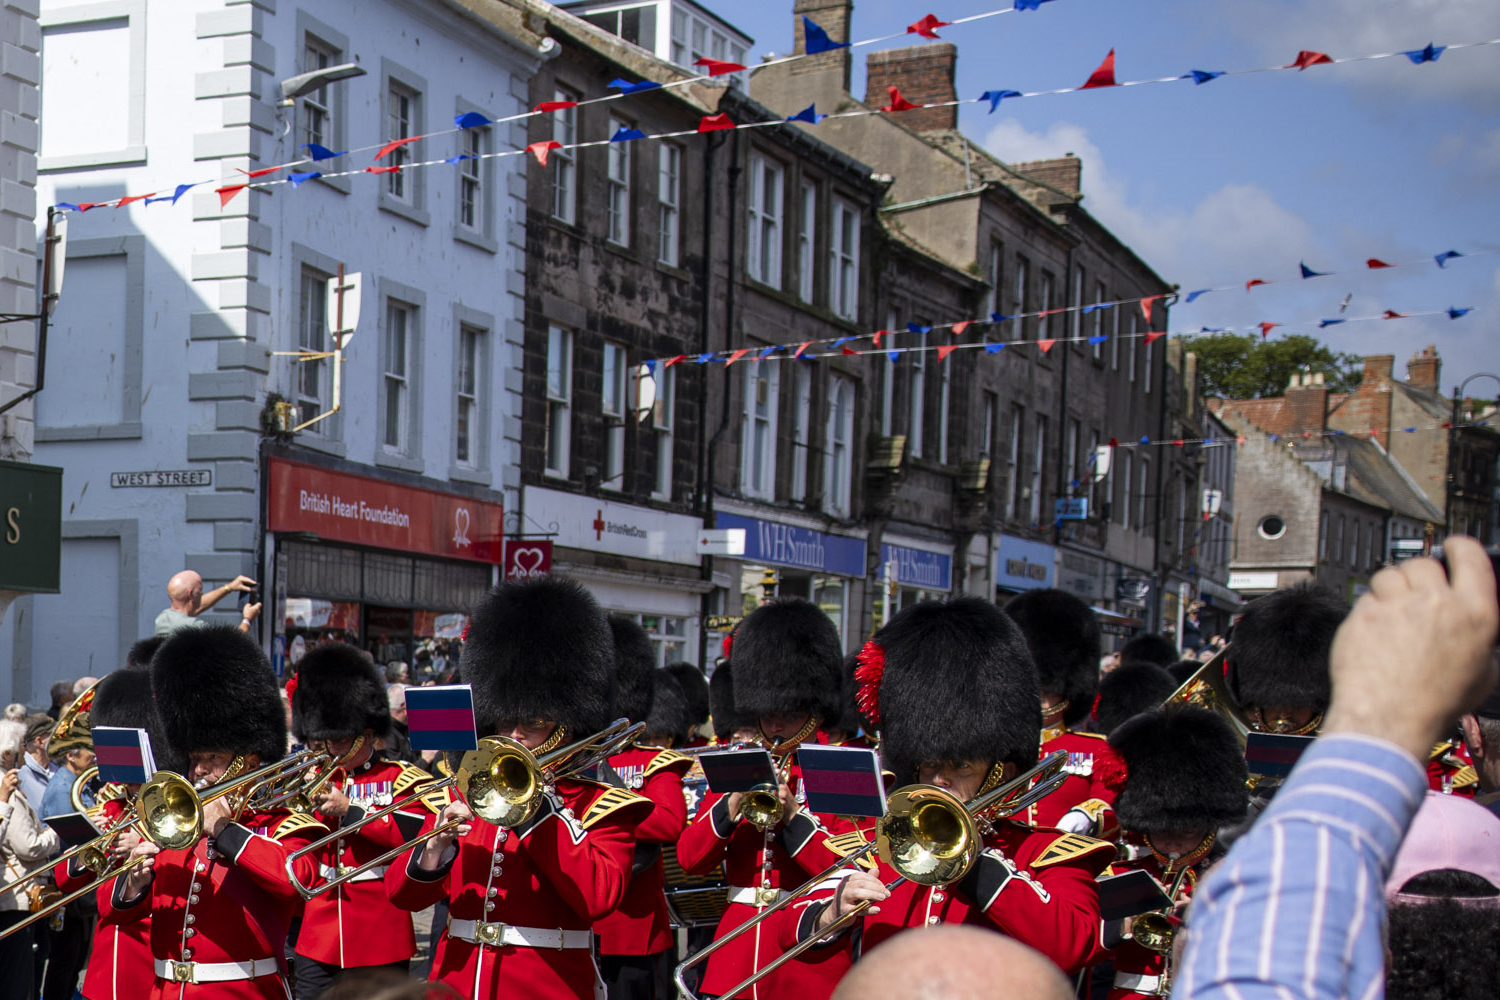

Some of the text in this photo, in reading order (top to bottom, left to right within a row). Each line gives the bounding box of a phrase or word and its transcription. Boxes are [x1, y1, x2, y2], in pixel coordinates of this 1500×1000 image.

[117, 472, 205, 485] WEST STREET
[300, 489, 410, 528] British Heart Foundation
[758, 520, 825, 569] WHSmith
